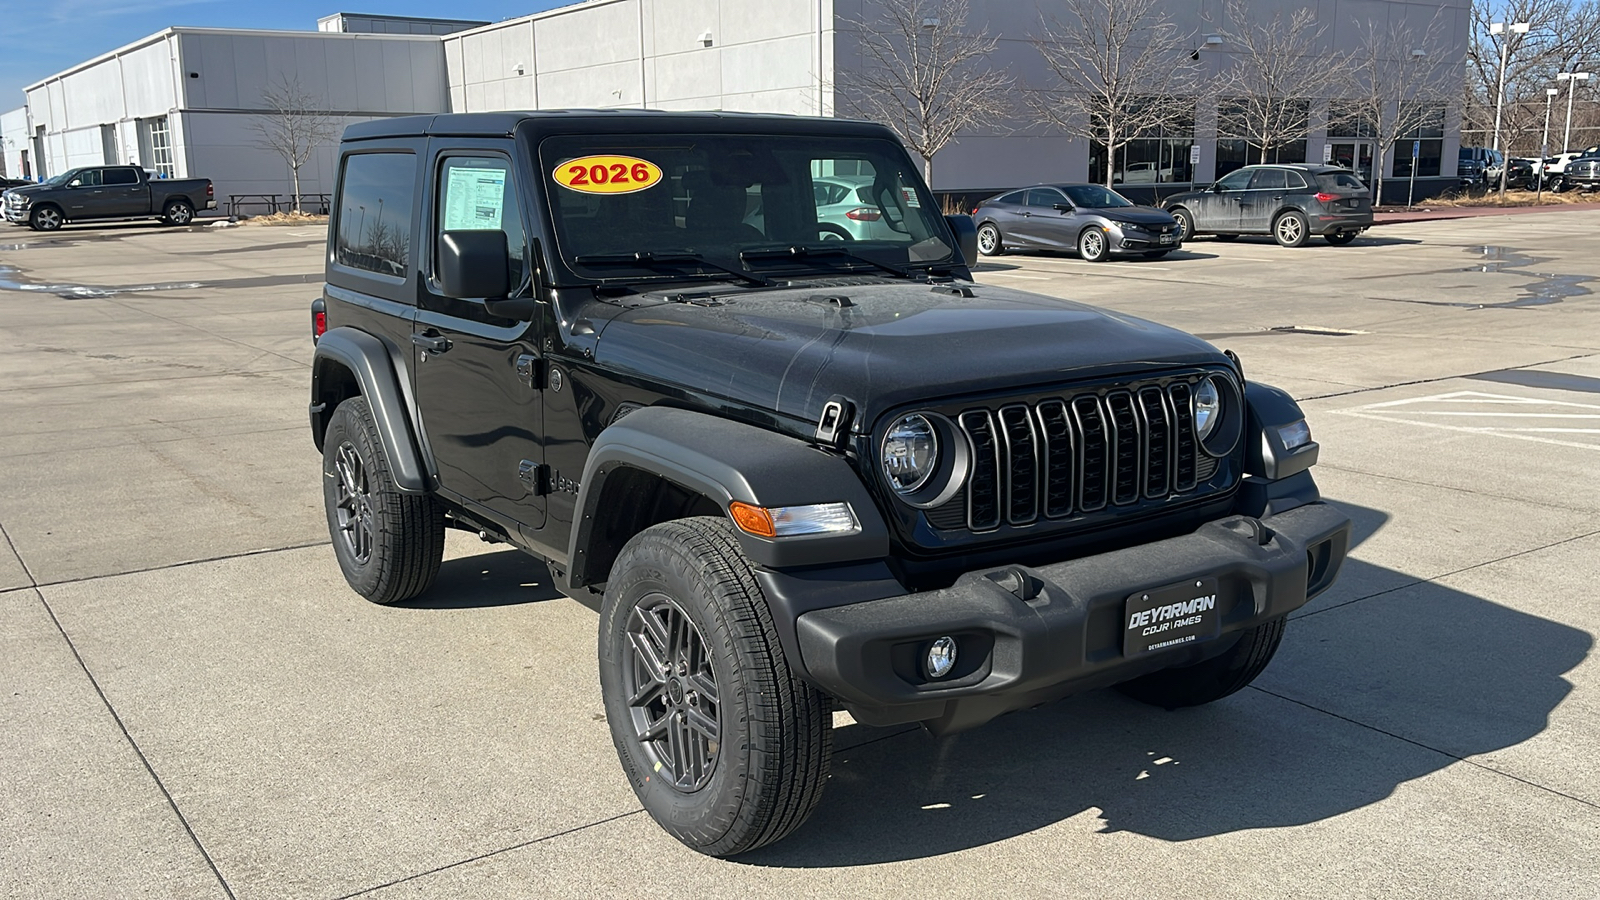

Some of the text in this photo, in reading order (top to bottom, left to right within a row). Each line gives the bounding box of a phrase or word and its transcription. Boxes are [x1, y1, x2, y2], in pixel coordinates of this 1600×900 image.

[568, 163, 650, 186] 2026
[1128, 594, 1216, 630] DEYARMAN
[1142, 615, 1203, 636] CDJR AMES
[1148, 634, 1196, 651] DEYARMANAMES.COM
